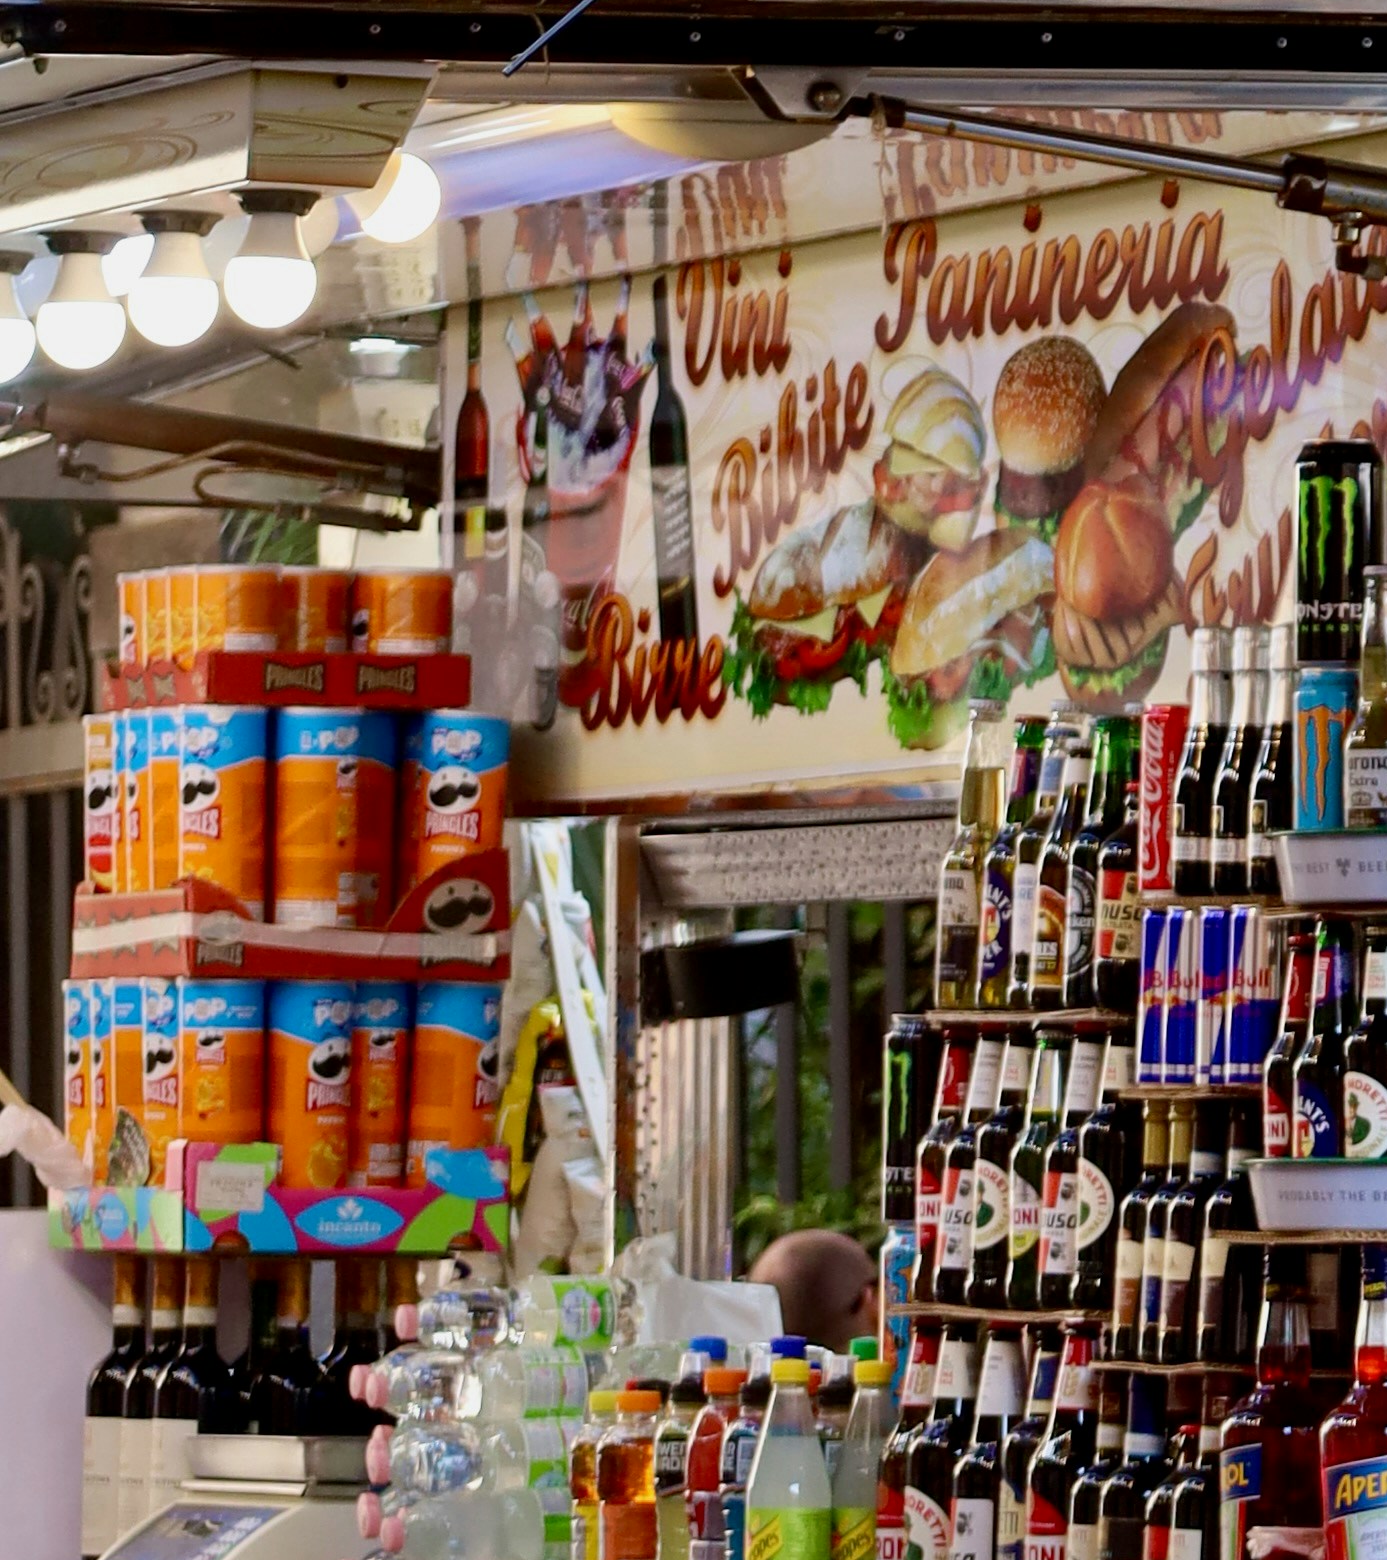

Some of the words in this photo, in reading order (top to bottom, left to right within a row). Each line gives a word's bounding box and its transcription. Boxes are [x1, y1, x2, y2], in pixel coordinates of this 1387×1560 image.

[676, 248, 793, 386] Vini
[874, 178, 1229, 352] Panineria
[713, 357, 875, 598] Bibite
[580, 591, 729, 732] Birre
[424, 810, 481, 842] PRINGLES
[1339, 1189, 1367, 1202] THE
